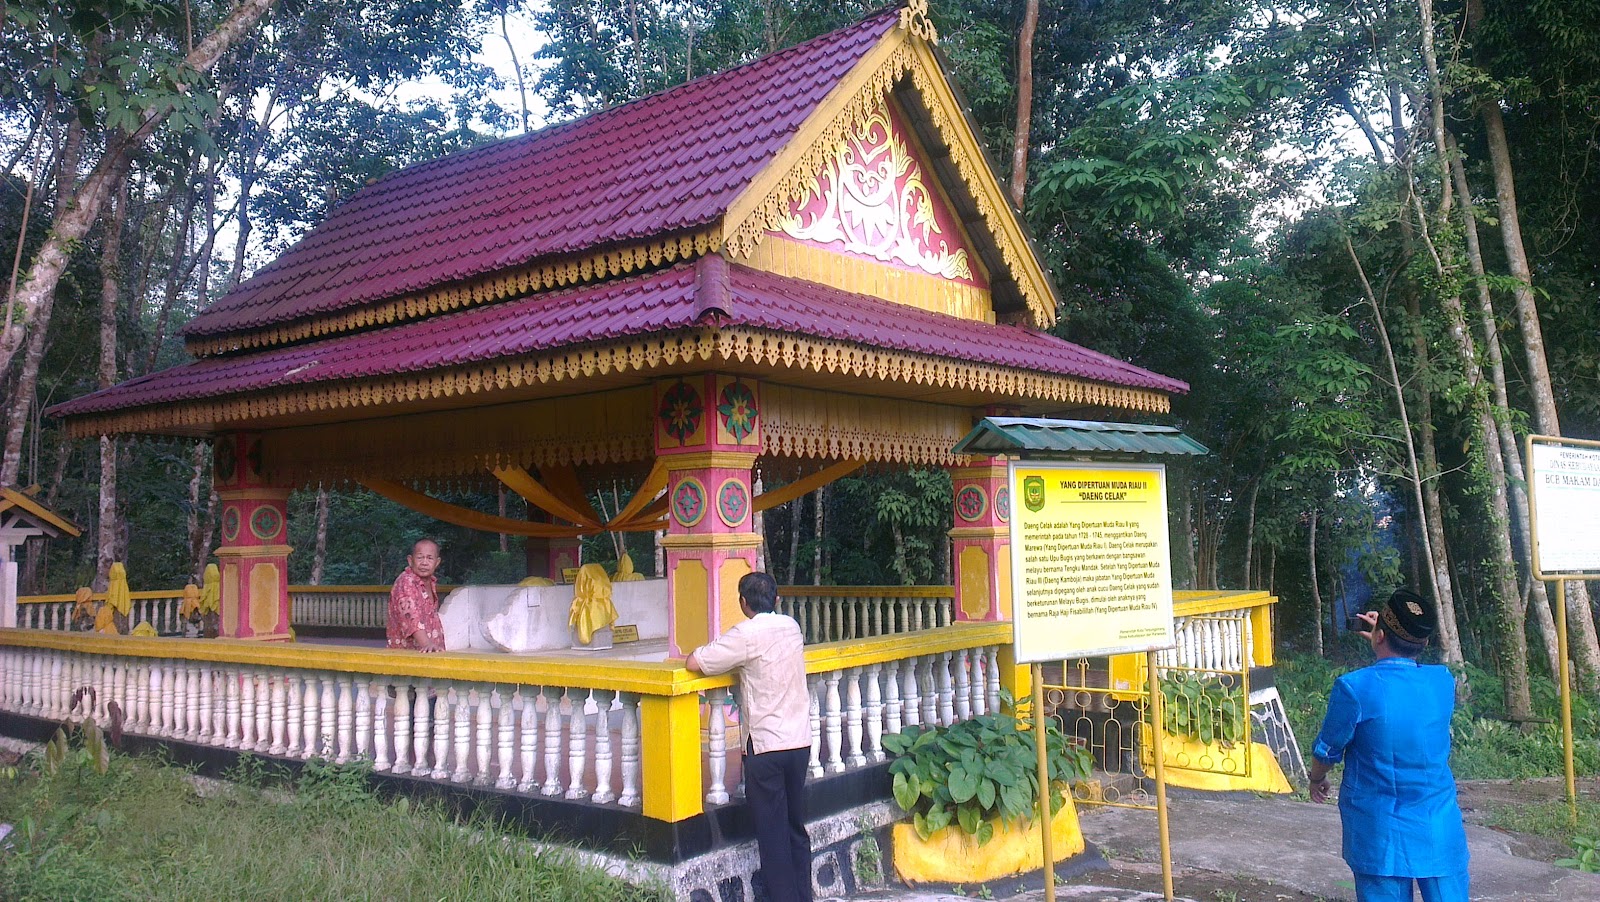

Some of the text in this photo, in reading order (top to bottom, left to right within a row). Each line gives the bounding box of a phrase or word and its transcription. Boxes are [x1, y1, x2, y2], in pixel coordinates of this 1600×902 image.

[1546, 473, 1561, 484] BCB
[1562, 475, 1591, 486] MAKAM
[1060, 481, 1077, 489] YANG
[1078, 481, 1110, 490] DIPERTUAN
[1128, 482, 1141, 490] RIAU
[1024, 522, 1039, 530] Daeng
[1069, 522, 1080, 530] Yang
[1104, 531, 1133, 540] menggantikan
[1134, 531, 1147, 539] Daeng
[1044, 544, 1056, 552] (Yang
[1058, 543, 1080, 551] Dipertuan
[1108, 542, 1122, 550] Daeng
[1050, 554, 1060, 562] Upu
[1060, 554, 1074, 562] Bugis
[1064, 564, 1080, 573] Tengku
[1043, 576, 1060, 585] (Daeng
[1095, 574, 1111, 582] jabatan
[1027, 588, 1053, 596] selanjutnya
[1109, 584, 1123, 592] Daeng
[1058, 598, 1075, 606] Melayu
[1048, 610, 1060, 618] Raja
[1060, 609, 1069, 618] Haji
[1094, 606, 1107, 615] (Yang
